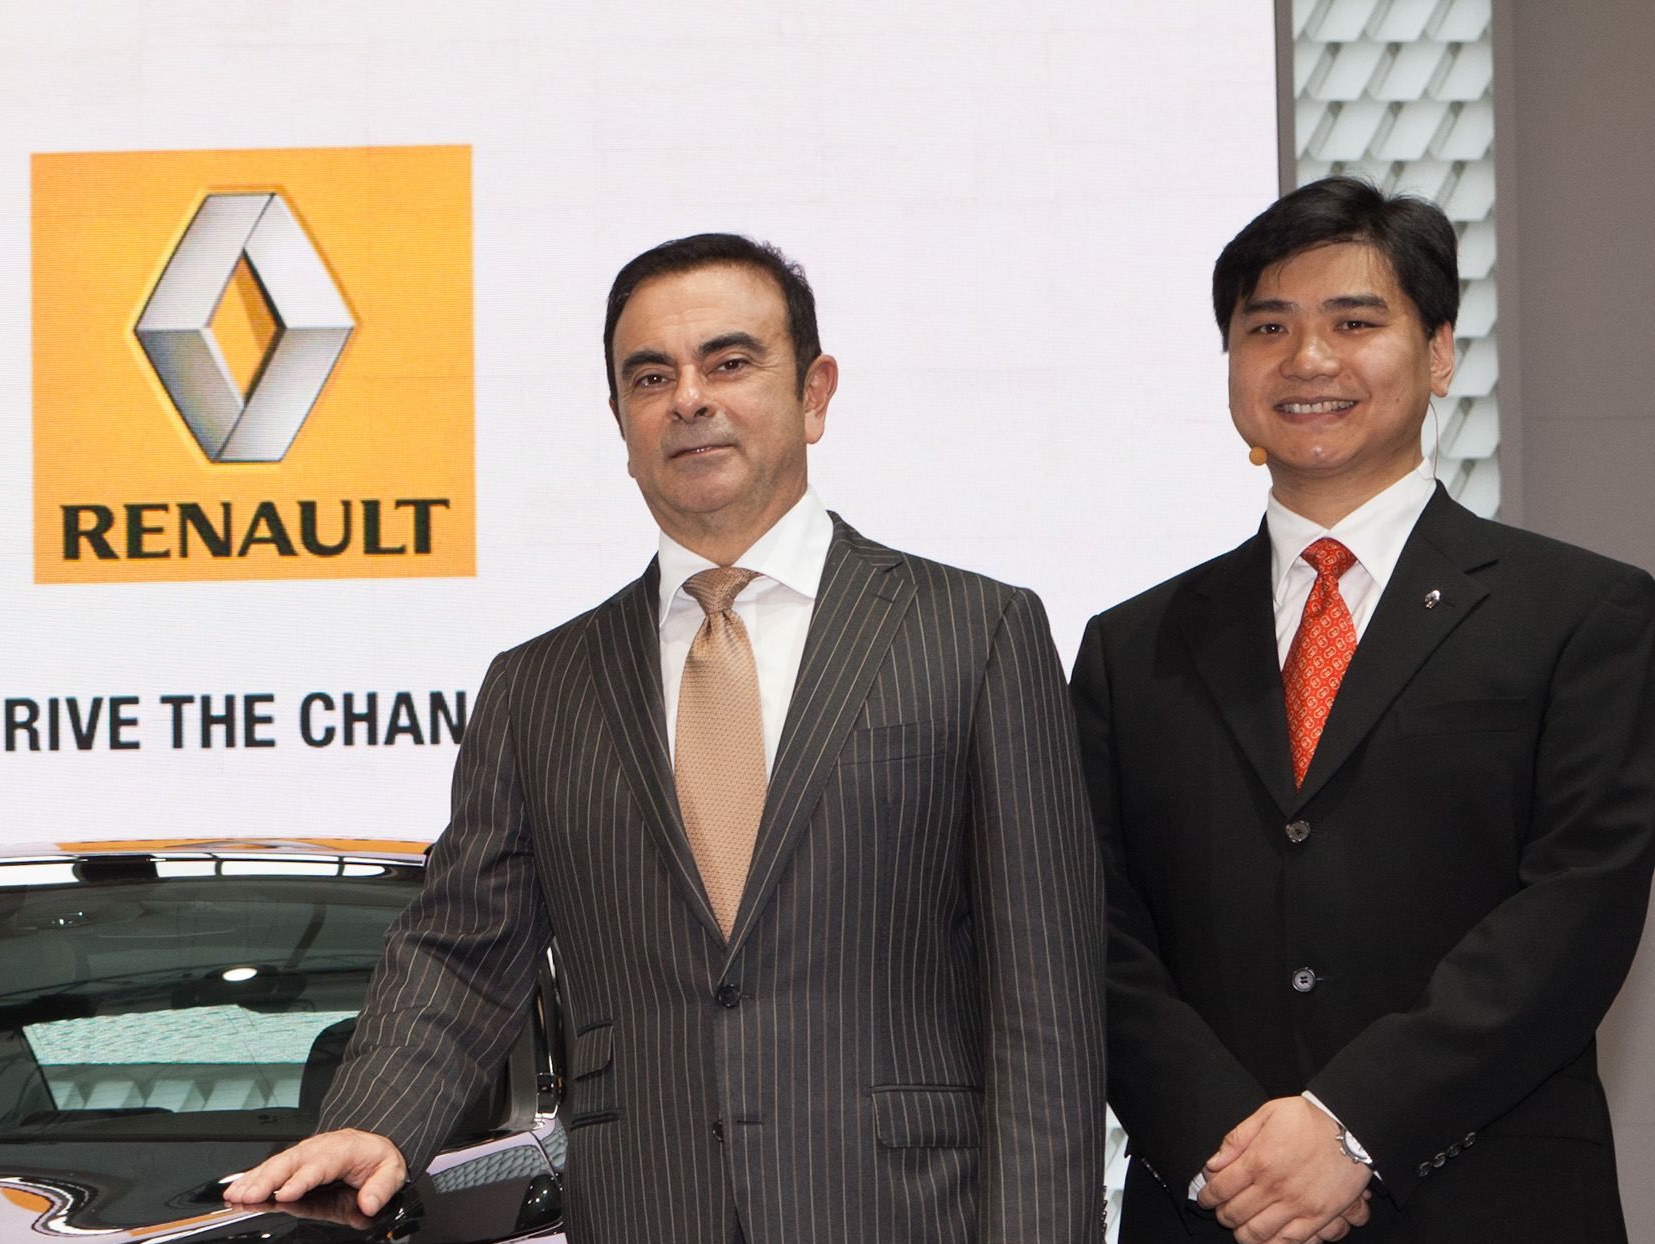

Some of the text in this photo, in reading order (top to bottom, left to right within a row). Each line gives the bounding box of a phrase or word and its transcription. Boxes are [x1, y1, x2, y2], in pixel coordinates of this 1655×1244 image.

[60, 498, 451, 561] RENAULT
[159, 693, 276, 750] THE
[299, 690, 467, 748] CHAN
